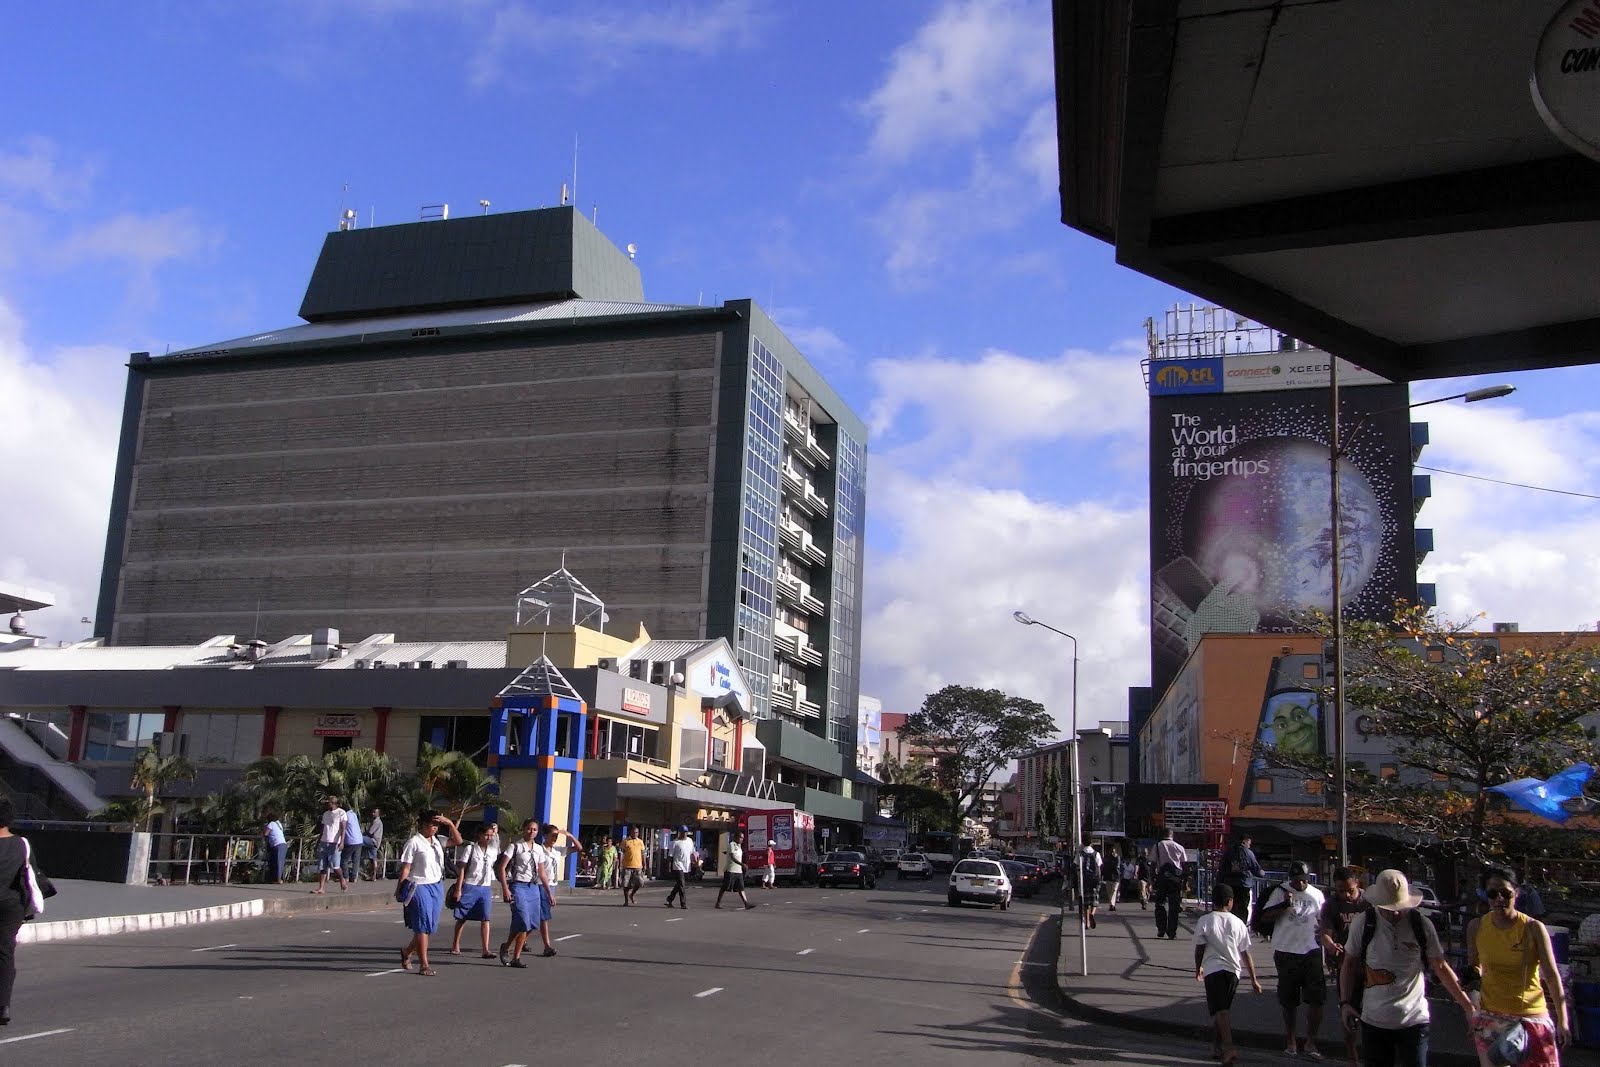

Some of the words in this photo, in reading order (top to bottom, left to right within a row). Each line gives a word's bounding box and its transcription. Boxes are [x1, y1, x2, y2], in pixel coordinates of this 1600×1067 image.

[1227, 366, 1272, 377] connect
[1289, 364, 1331, 373] XCEED
[1172, 413, 1200, 427] The
[1171, 425, 1236, 445] World
[1172, 445, 1186, 458] at
[1193, 446, 1227, 460] your
[1172, 458, 1270, 481] fingertips
